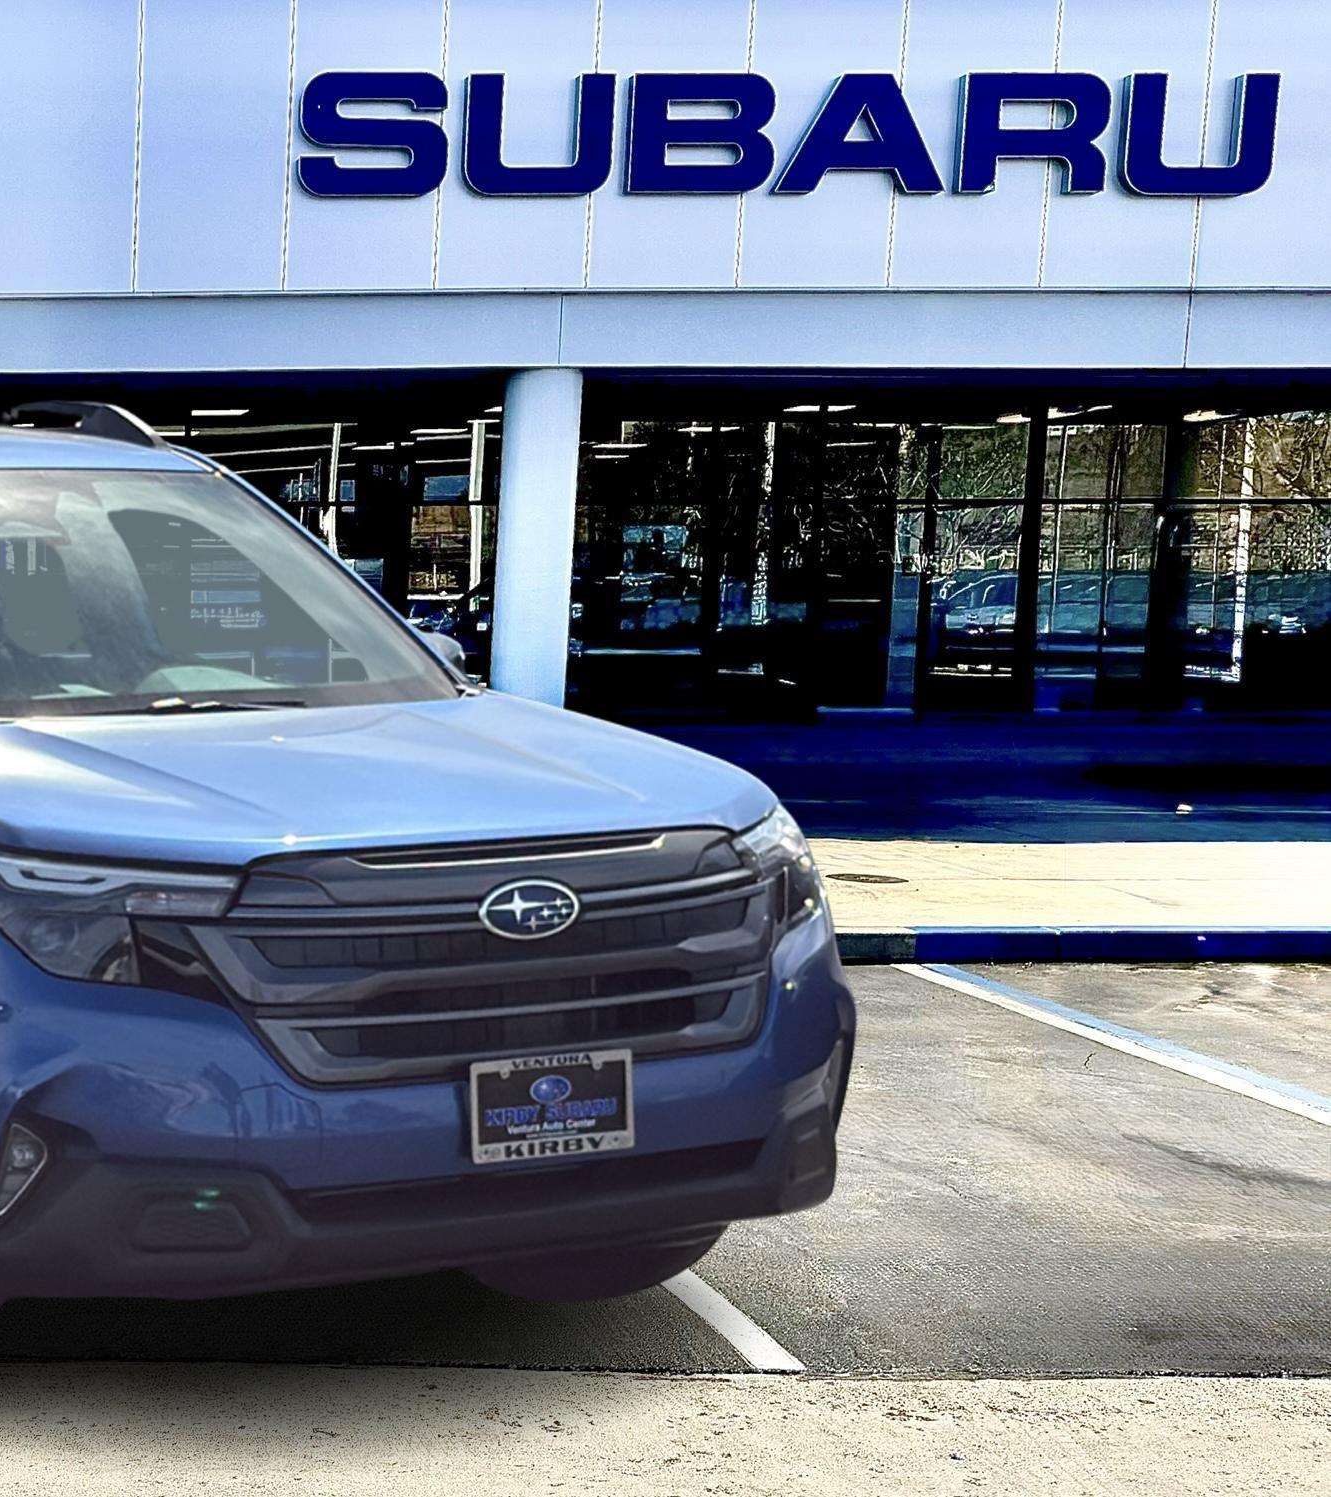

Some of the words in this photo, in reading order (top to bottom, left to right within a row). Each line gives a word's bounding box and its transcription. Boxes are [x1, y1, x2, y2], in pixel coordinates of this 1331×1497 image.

[296, 72, 1281, 199] SUBARU
[512, 1054, 592, 1069] VENTURA
[485, 1105, 540, 1126] KIRBY
[546, 1098, 617, 1119] SUBARU
[507, 1121, 540, 1135] Ventura
[542, 1120, 565, 1131] Auto
[566, 1118, 596, 1129] Center
[506, 1136, 604, 1158] KIRBY
